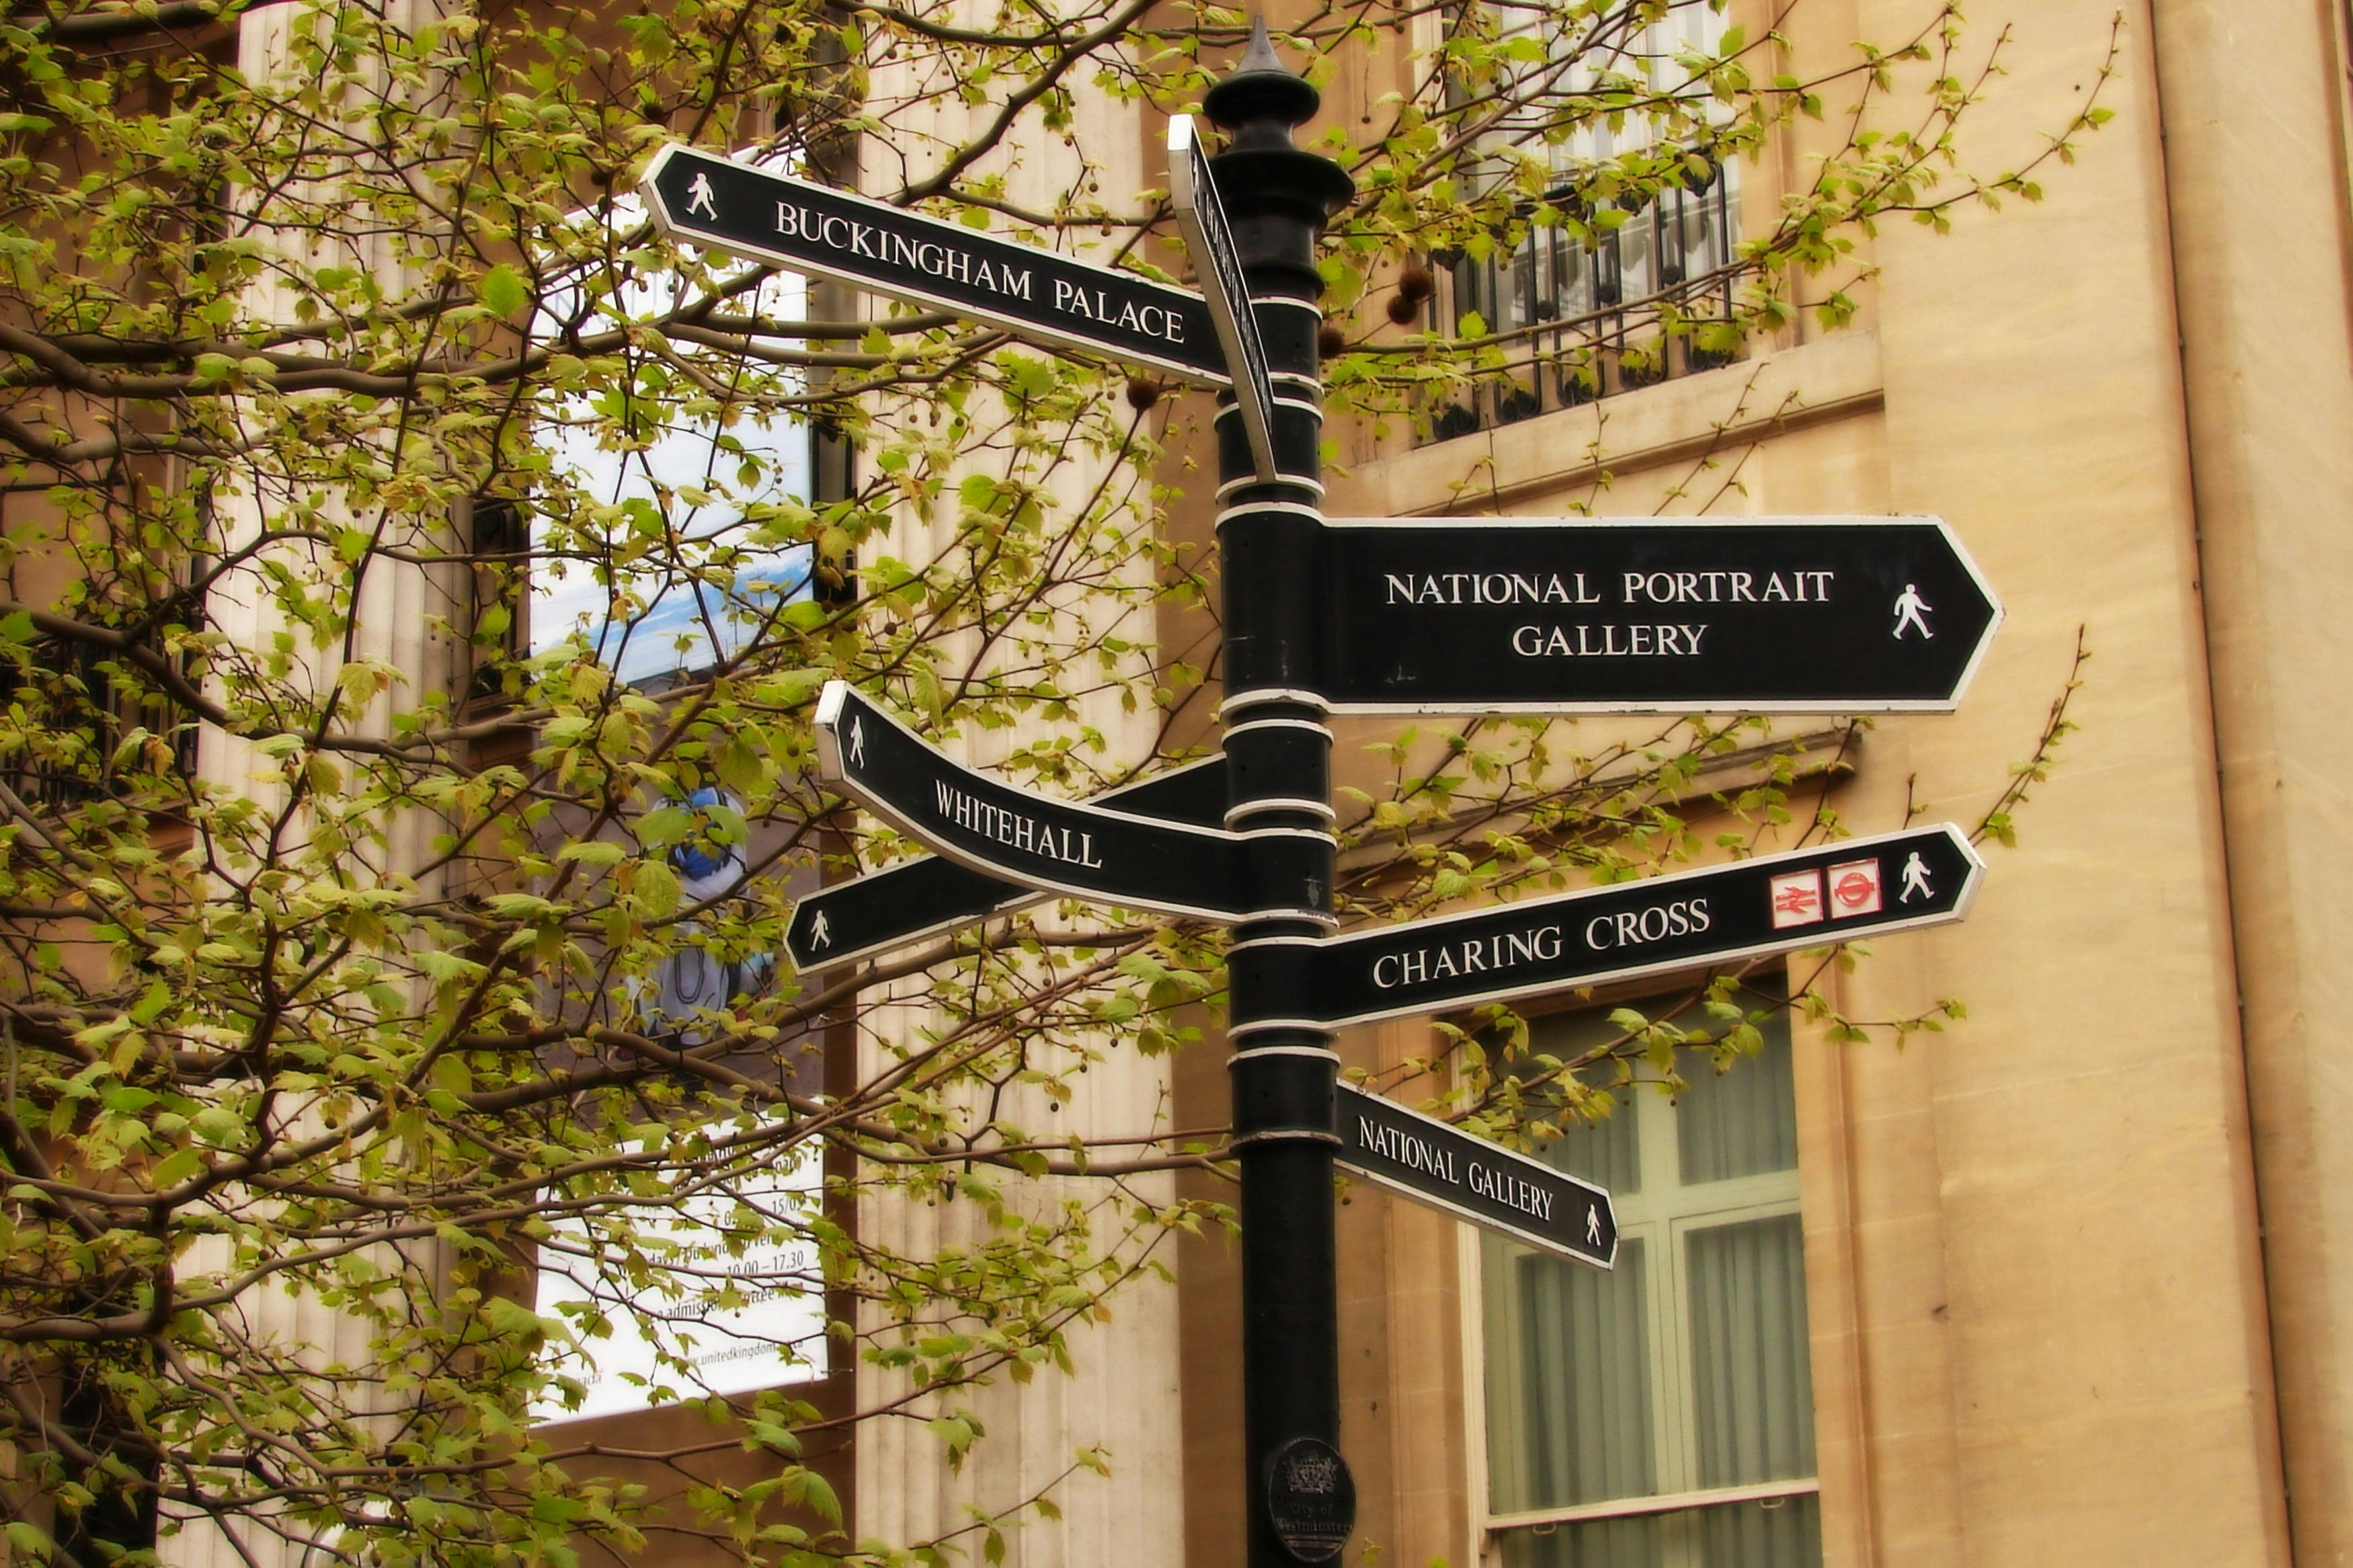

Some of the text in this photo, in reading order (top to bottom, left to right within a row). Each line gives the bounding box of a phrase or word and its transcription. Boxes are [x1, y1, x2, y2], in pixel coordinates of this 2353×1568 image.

[774, 201, 1033, 302] BUCKINGHAM
[1053, 278, 1185, 344] PALACE
[1384, 571, 1834, 604] NATIONAL PORTRAIT
[1512, 624, 1708, 656] GALLERY
[935, 779, 1103, 869] WHITEHALL
[1373, 898, 1710, 988] CHARING CROSS
[1359, 1114, 1554, 1222] NATIONAL GALLERY
[773, 1250, 804, 1272] 17.30
